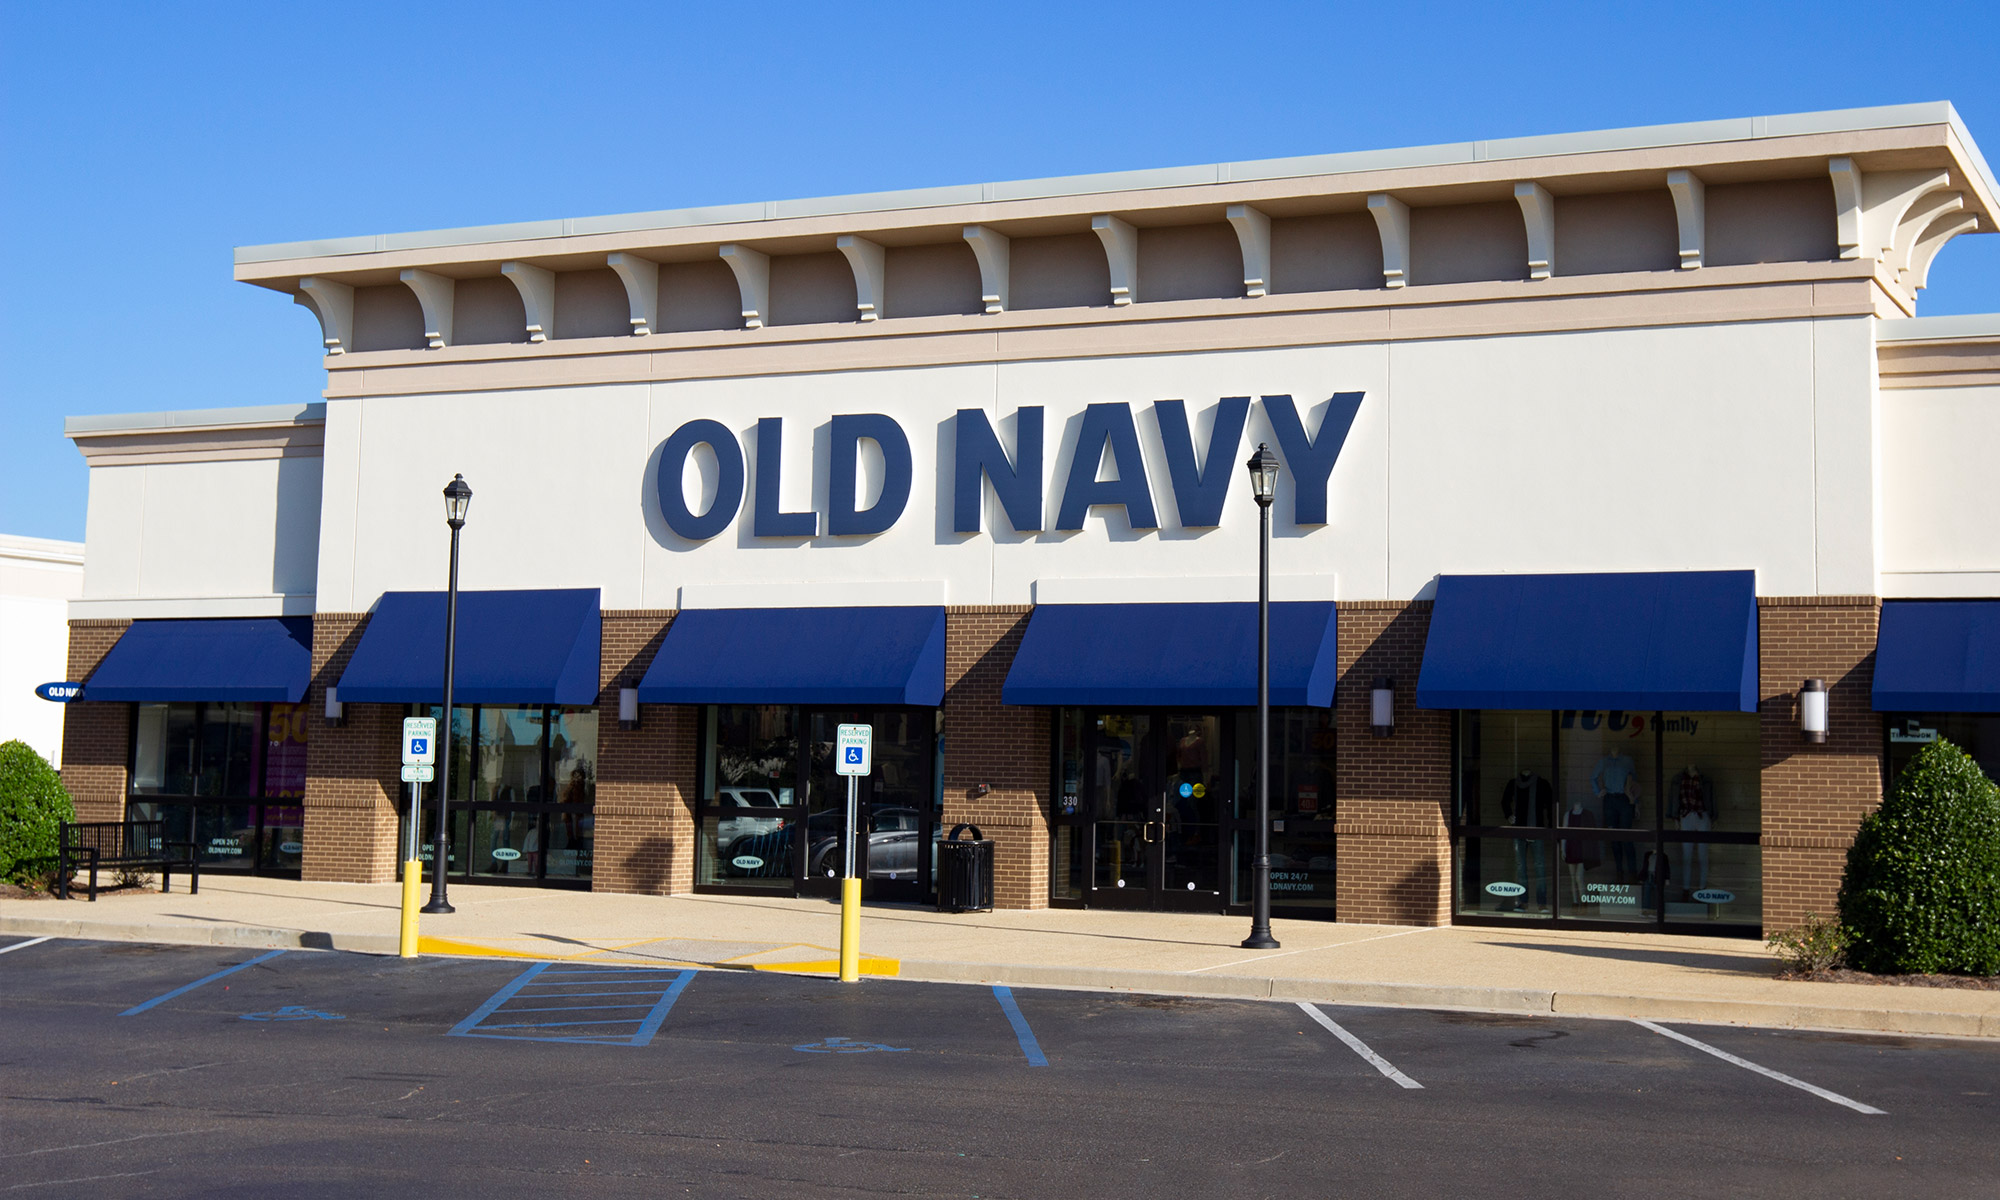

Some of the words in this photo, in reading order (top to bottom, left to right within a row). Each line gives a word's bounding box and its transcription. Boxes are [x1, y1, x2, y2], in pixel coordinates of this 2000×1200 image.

[657, 413, 912, 540] OLD
[954, 391, 1366, 533] NAVY
[48, 687, 65, 697] OLD
[841, 729, 870, 737] RESERVED
[1063, 796, 1078, 806] 330
[212, 838, 225, 846] OPEN
[226, 838, 239, 847] 24/7
[208, 846, 243, 855] OLDNAVY.COM
[559, 859, 593, 867] OLDNAVY.CO
[1270, 872, 1288, 880] OPEN
[1291, 872, 1308, 882] 24/7
[1269, 882, 1314, 891] LDNAVY.COM
[1587, 883, 1608, 892] OPEN
[1610, 884, 1630, 894] 24/7
[1581, 894, 1636, 905] OLDNAVY.COM
